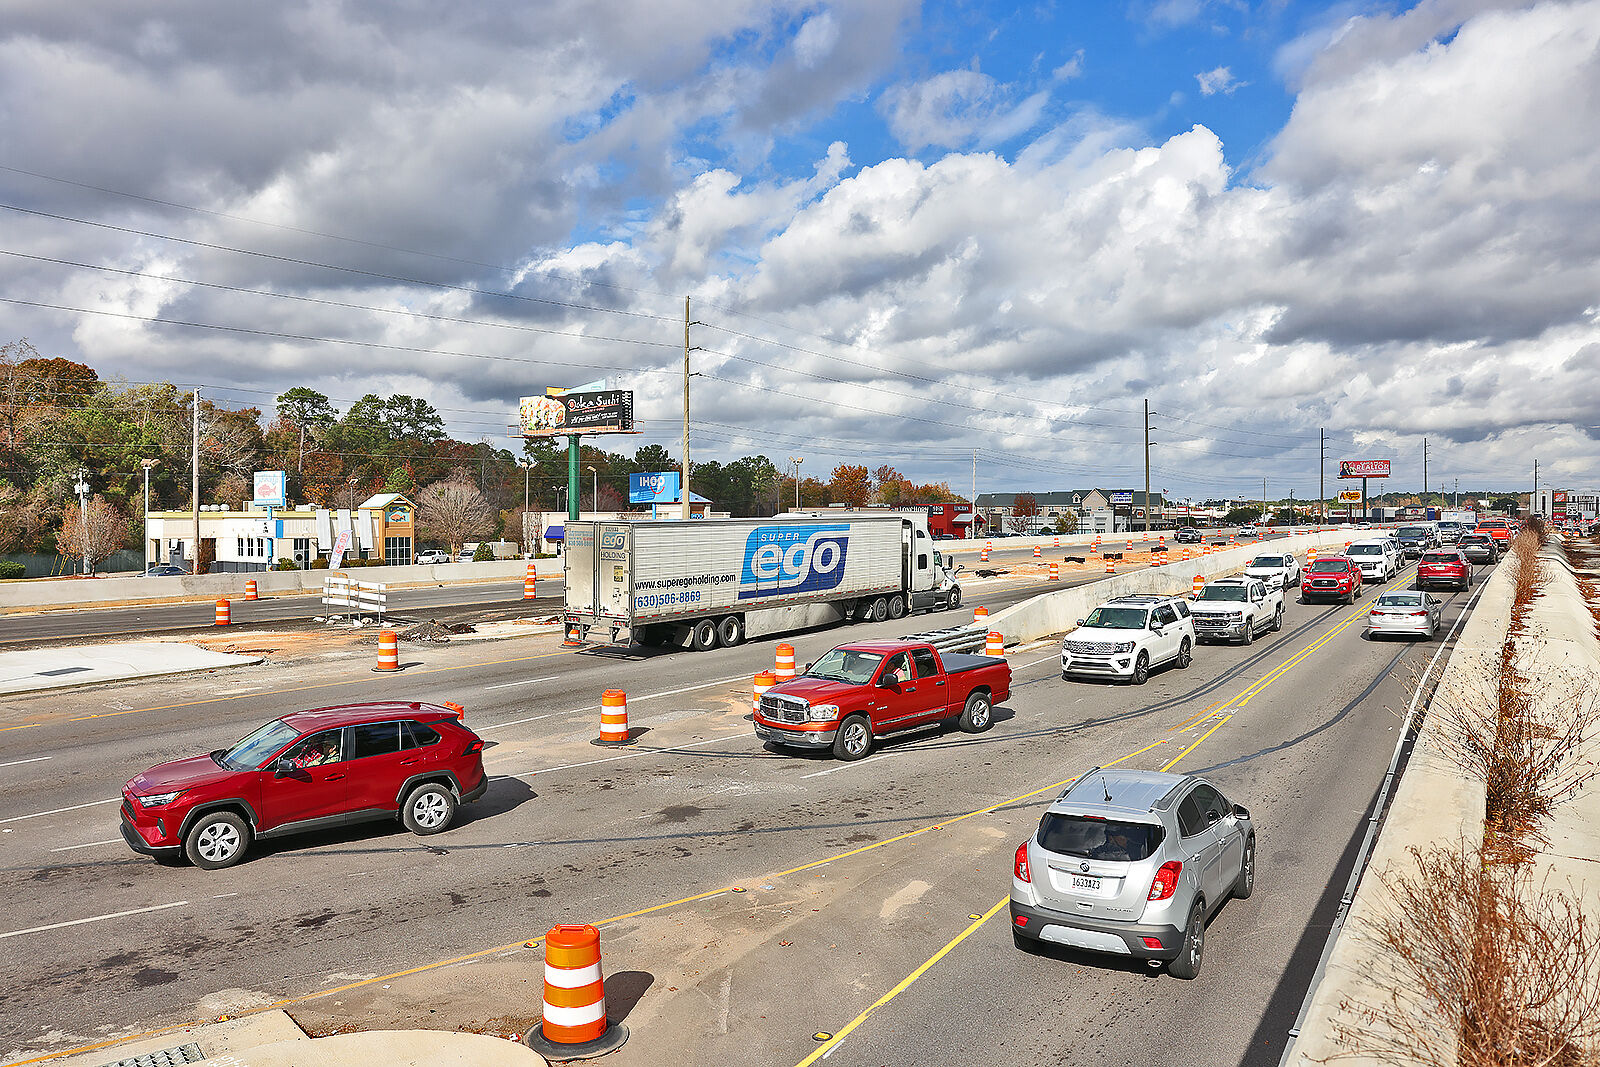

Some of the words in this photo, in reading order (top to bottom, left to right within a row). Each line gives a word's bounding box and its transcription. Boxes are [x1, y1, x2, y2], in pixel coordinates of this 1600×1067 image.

[596, 393, 620, 406] Sushi
[760, 532, 800, 542] SUPER
[600, 551, 626, 560] HOLDING
[750, 540, 842, 583] ego
[634, 573, 736, 590] www.superegoholding.com
[633, 590, 701, 609] (630)506-8869
